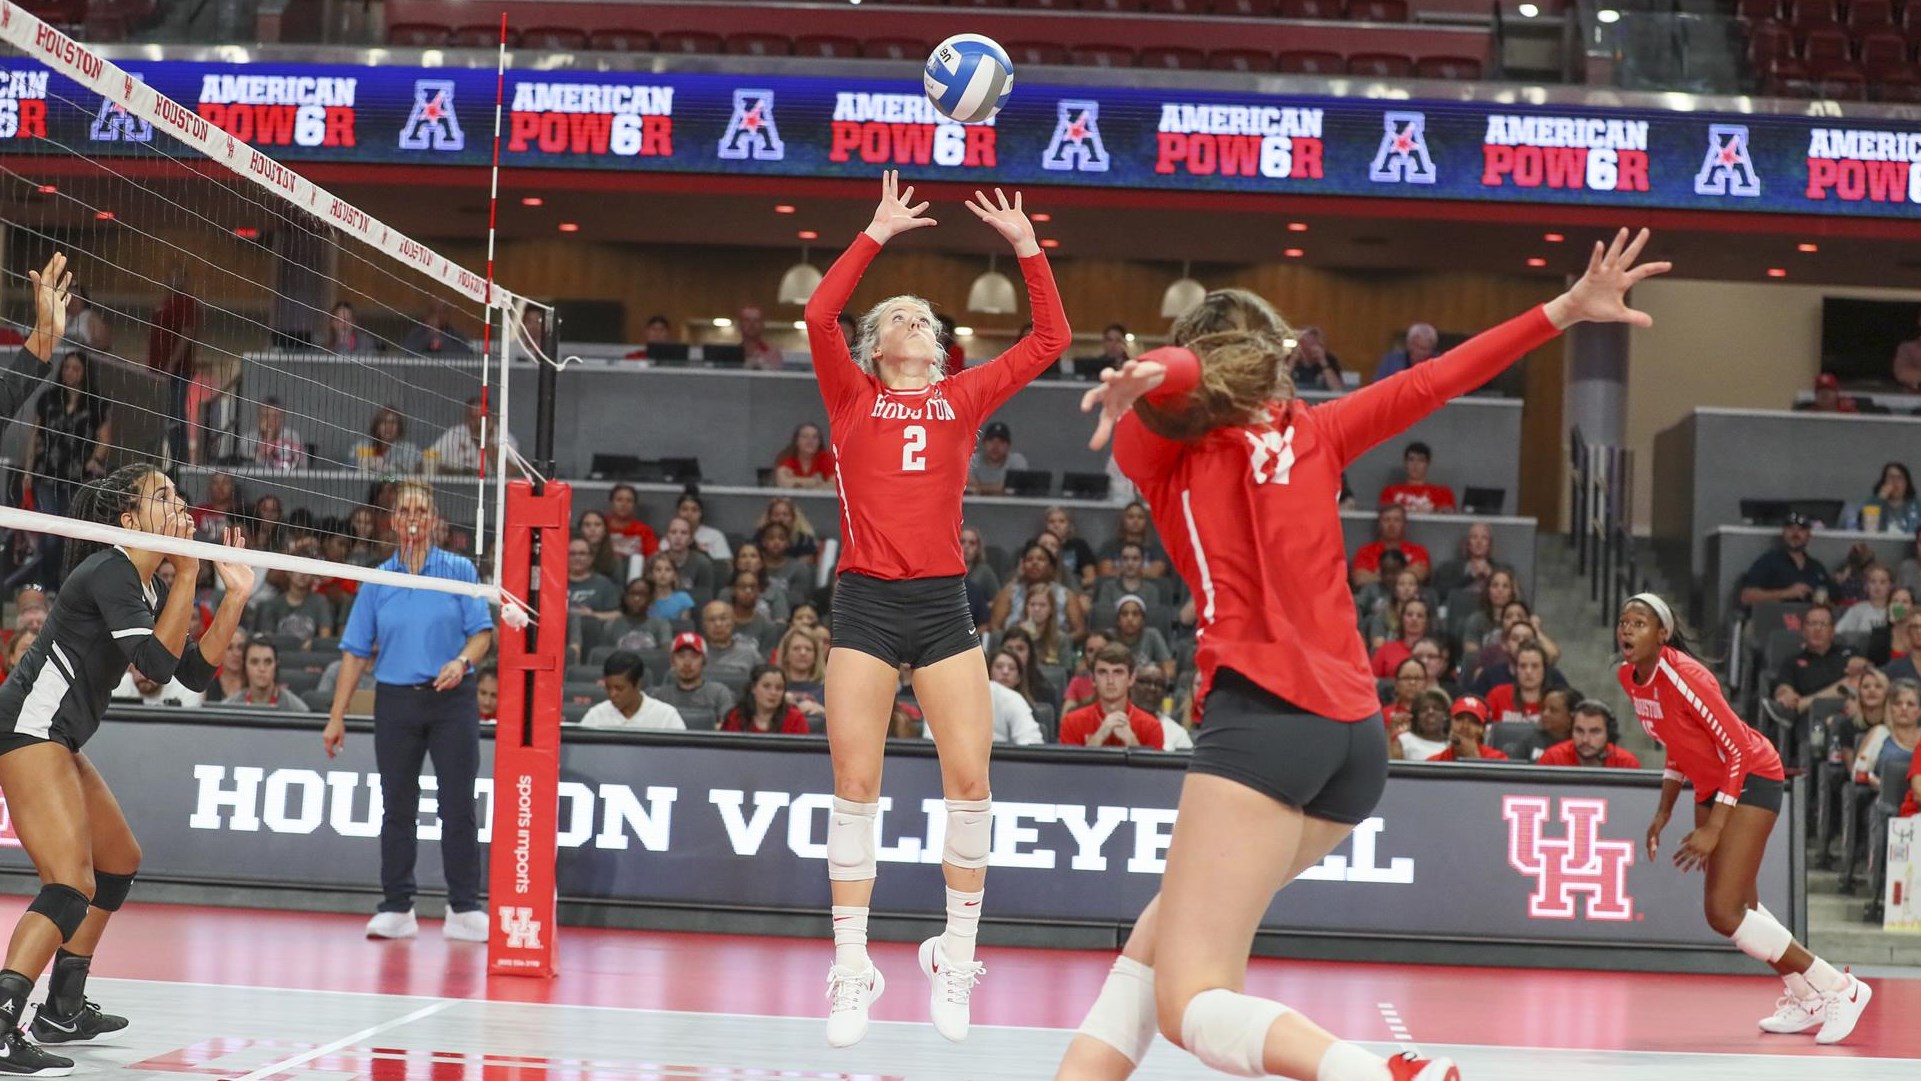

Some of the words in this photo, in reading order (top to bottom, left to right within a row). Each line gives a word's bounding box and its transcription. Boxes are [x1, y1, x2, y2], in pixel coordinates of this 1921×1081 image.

[36, 24, 103, 81] HOUSTON
[199, 74, 357, 106] AMERICAN
[511, 82, 674, 115] AMERICAN
[833, 92, 996, 126] AMERI
[155, 94, 209, 142] HOUSTON
[197, 102, 356, 147] POW6R
[508, 111, 673, 156] POW6R
[1158, 104, 1324, 138] AMERICAN
[1484, 115, 1649, 150] AMERICAN
[829, 121, 997, 167] POW6R
[1155, 132, 1324, 178] POW6R
[1808, 128, 1921, 162] AMERIC
[250, 150, 297, 193] HOUSTON
[1481, 143, 1649, 192] POW6R
[902, 425, 926, 471] 2
[516, 774, 532, 828] sports
[709, 789, 1414, 884] VOLEYBL
[1502, 794, 1634, 921] UH
[513, 830, 531, 894] imports
[499, 906, 541, 949] UH
